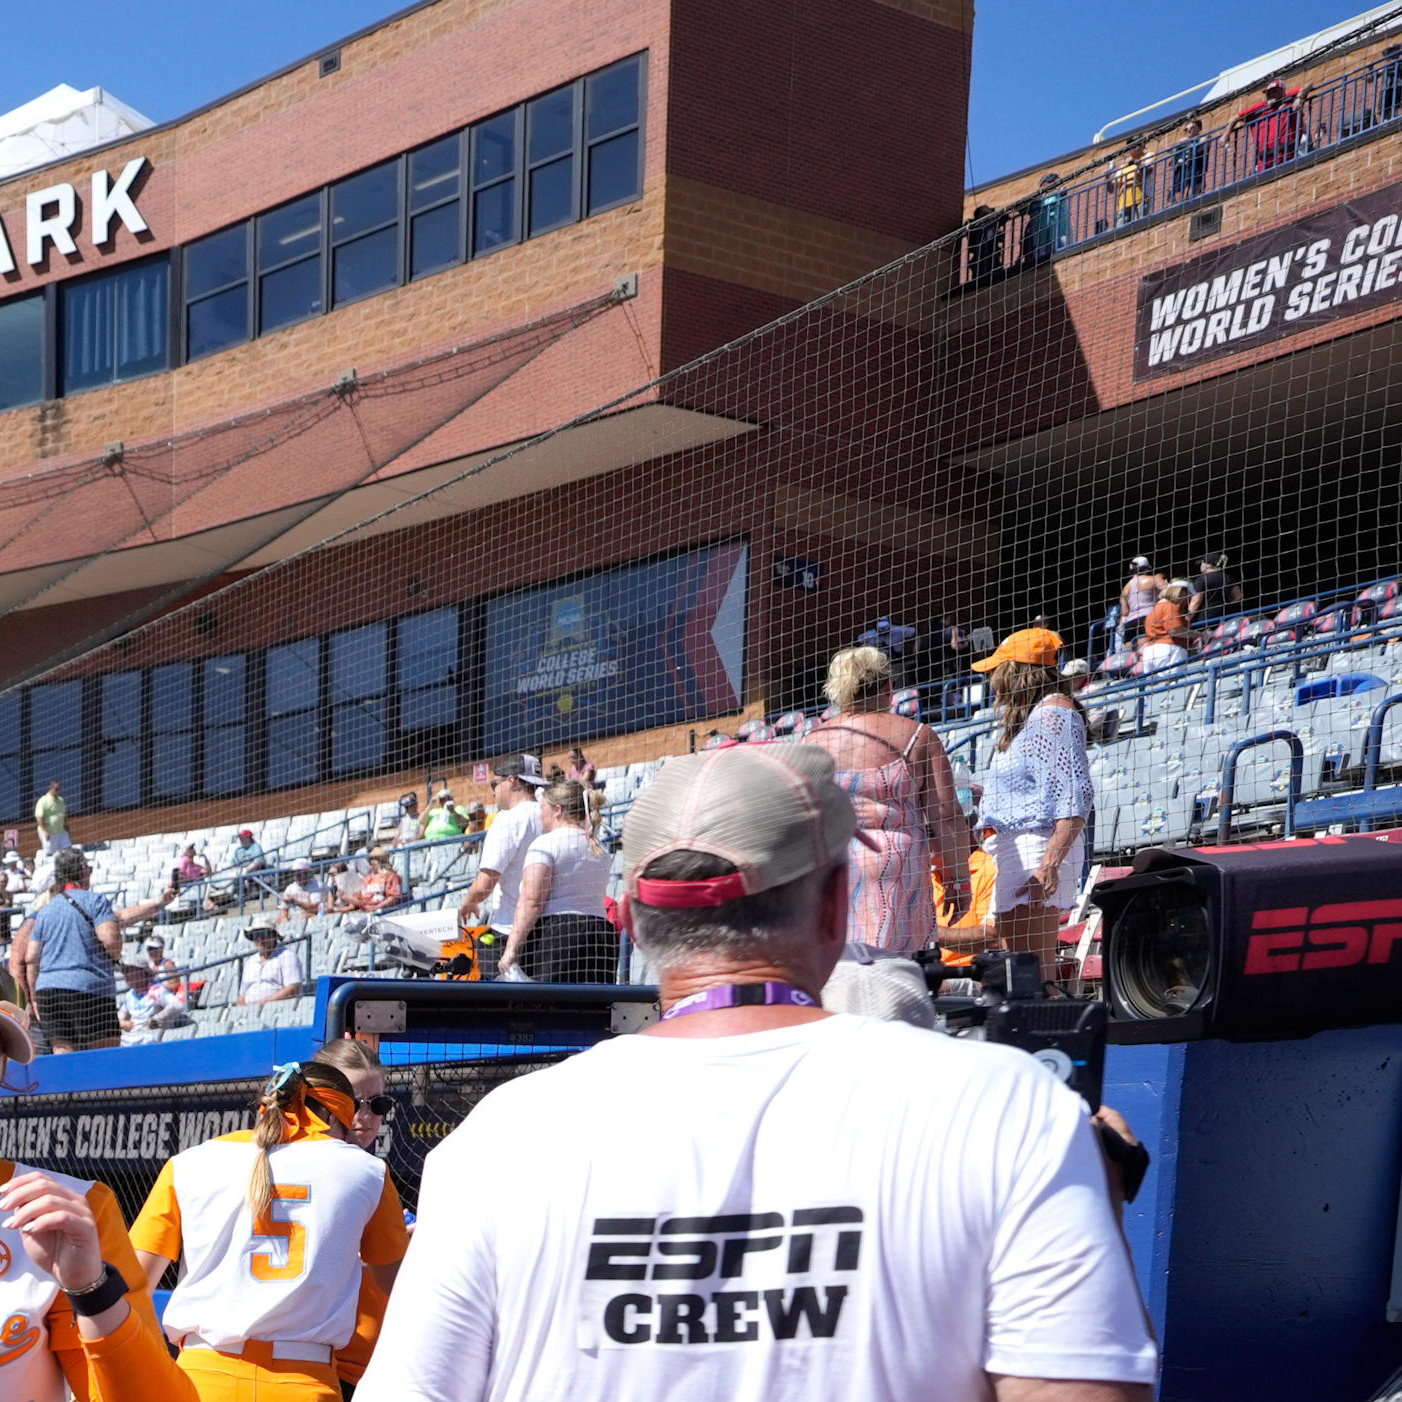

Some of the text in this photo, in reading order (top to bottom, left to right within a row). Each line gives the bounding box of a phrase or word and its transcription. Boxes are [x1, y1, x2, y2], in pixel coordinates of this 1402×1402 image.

[1147, 250, 1402, 367] WORLD SERIE
[1150, 238, 1332, 332] WOMEN'S
[516, 660, 619, 695] WORLD SERIES
[536, 648, 597, 673] COLLEGE
[74, 1112, 174, 1159] COLLEGE
[249, 1184, 311, 1283] 5
[585, 1206, 864, 1281] ESPN
[603, 1285, 848, 1344] CREW
